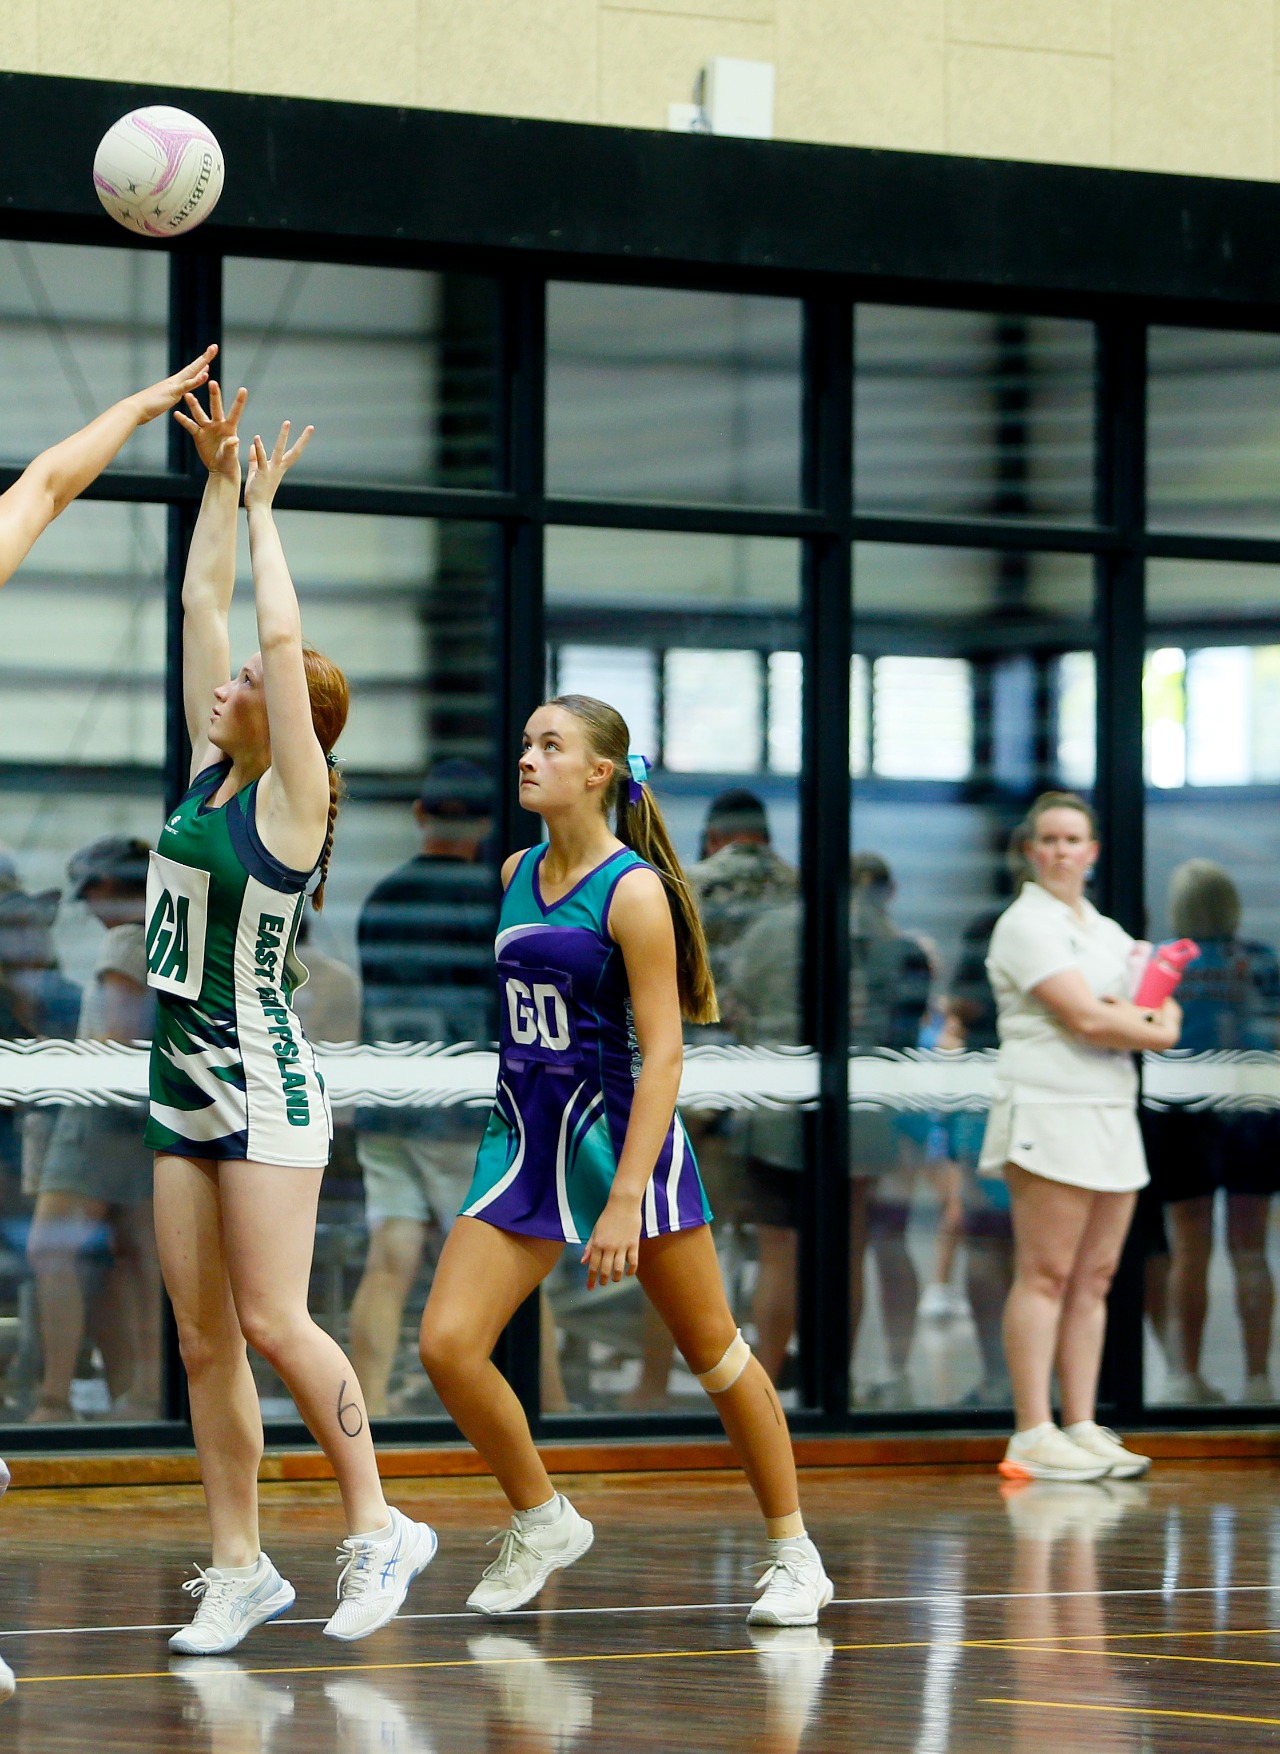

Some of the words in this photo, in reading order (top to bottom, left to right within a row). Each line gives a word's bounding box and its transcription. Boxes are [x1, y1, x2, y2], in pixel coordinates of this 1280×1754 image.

[169, 152, 213, 229] GILBERT
[145, 888, 190, 984] GA
[255, 911, 285, 983] EAST
[505, 977, 573, 1051] GD
[255, 986, 311, 1127] GIPPSLAND
[337, 1380, 363, 1435] 6
